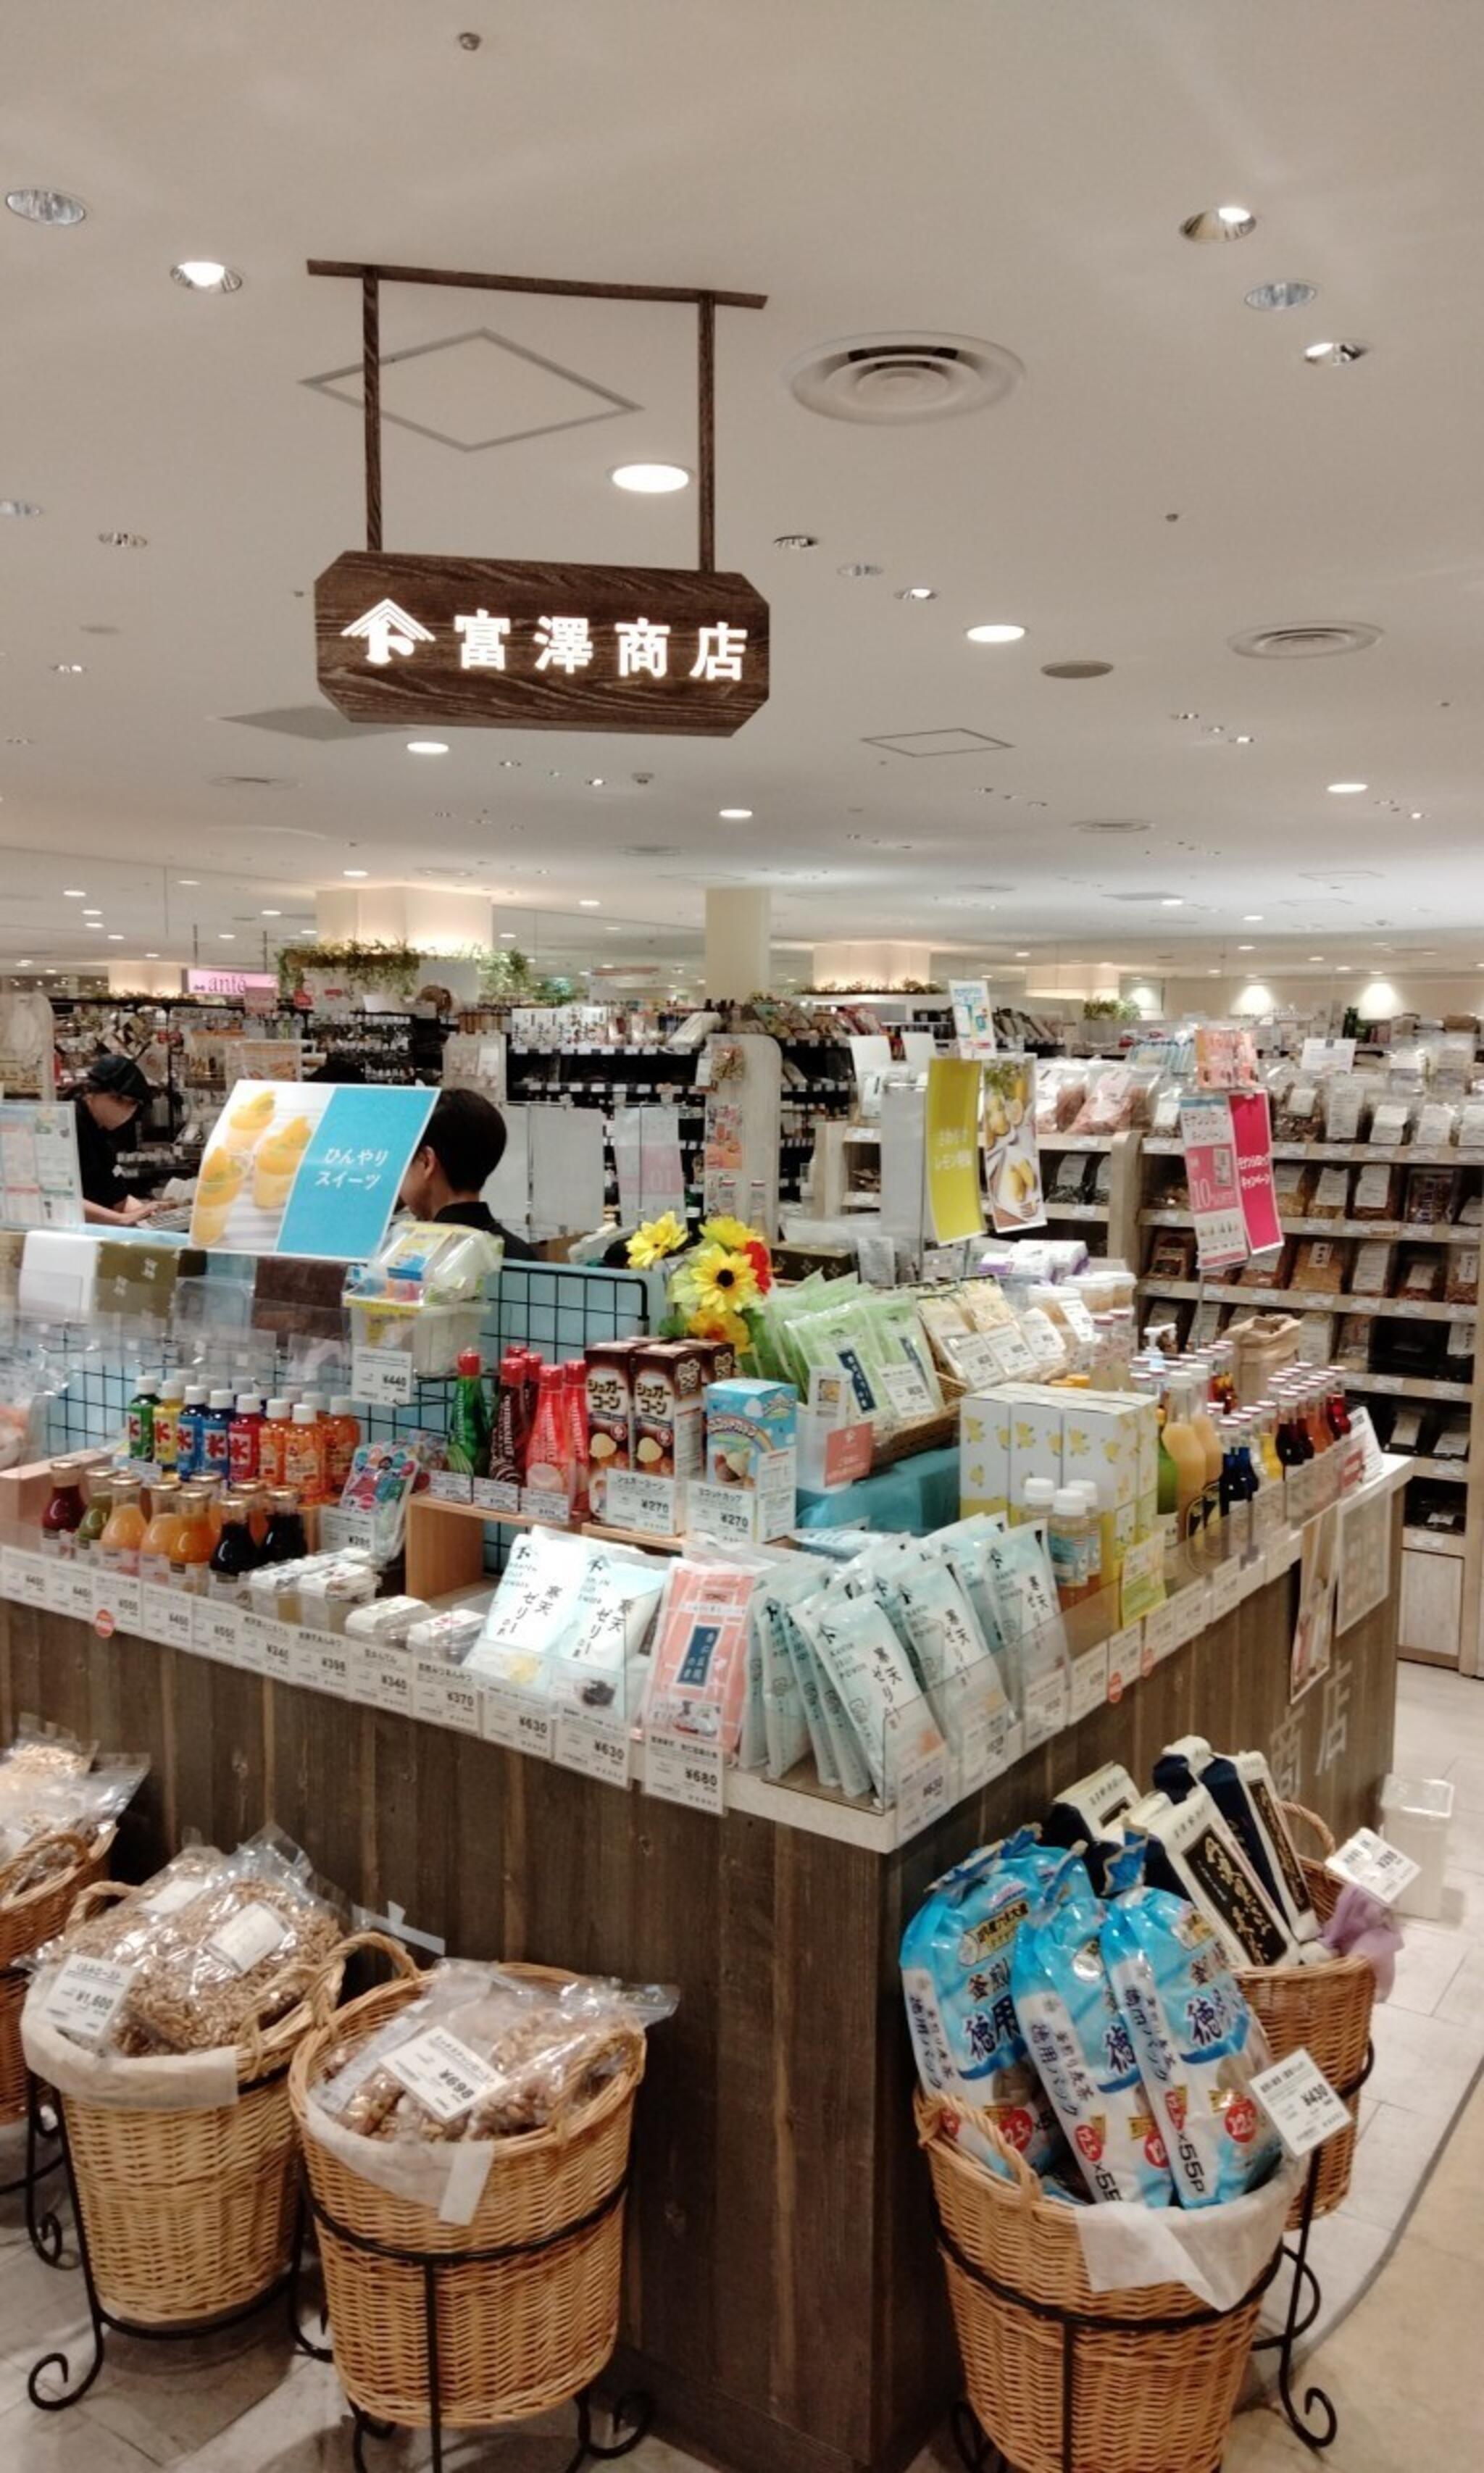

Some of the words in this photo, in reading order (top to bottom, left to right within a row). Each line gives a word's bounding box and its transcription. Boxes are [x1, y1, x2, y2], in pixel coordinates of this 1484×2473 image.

[453, 609, 749, 680] 富澤商店
[324, 1148, 389, 1167] ひんやり
[314, 1171, 382, 1190] スイーツ
[588, 1380, 625, 1395] シュガー
[635, 1383, 672, 1398] シュガー
[593, 1396, 621, 1410] コーン
[641, 1400, 667, 1414] コーン
[641, 1498, 670, 1514] ¥270
[720, 1512, 749, 1528] ¥270
[534, 1585, 563, 1617] 寒天
[519, 1715, 548, 1734] ¥630
[594, 1740, 625, 1761] ¥630
[685, 1767, 718, 1787] ¥680
[438, 2069, 475, 2099] ¥698
